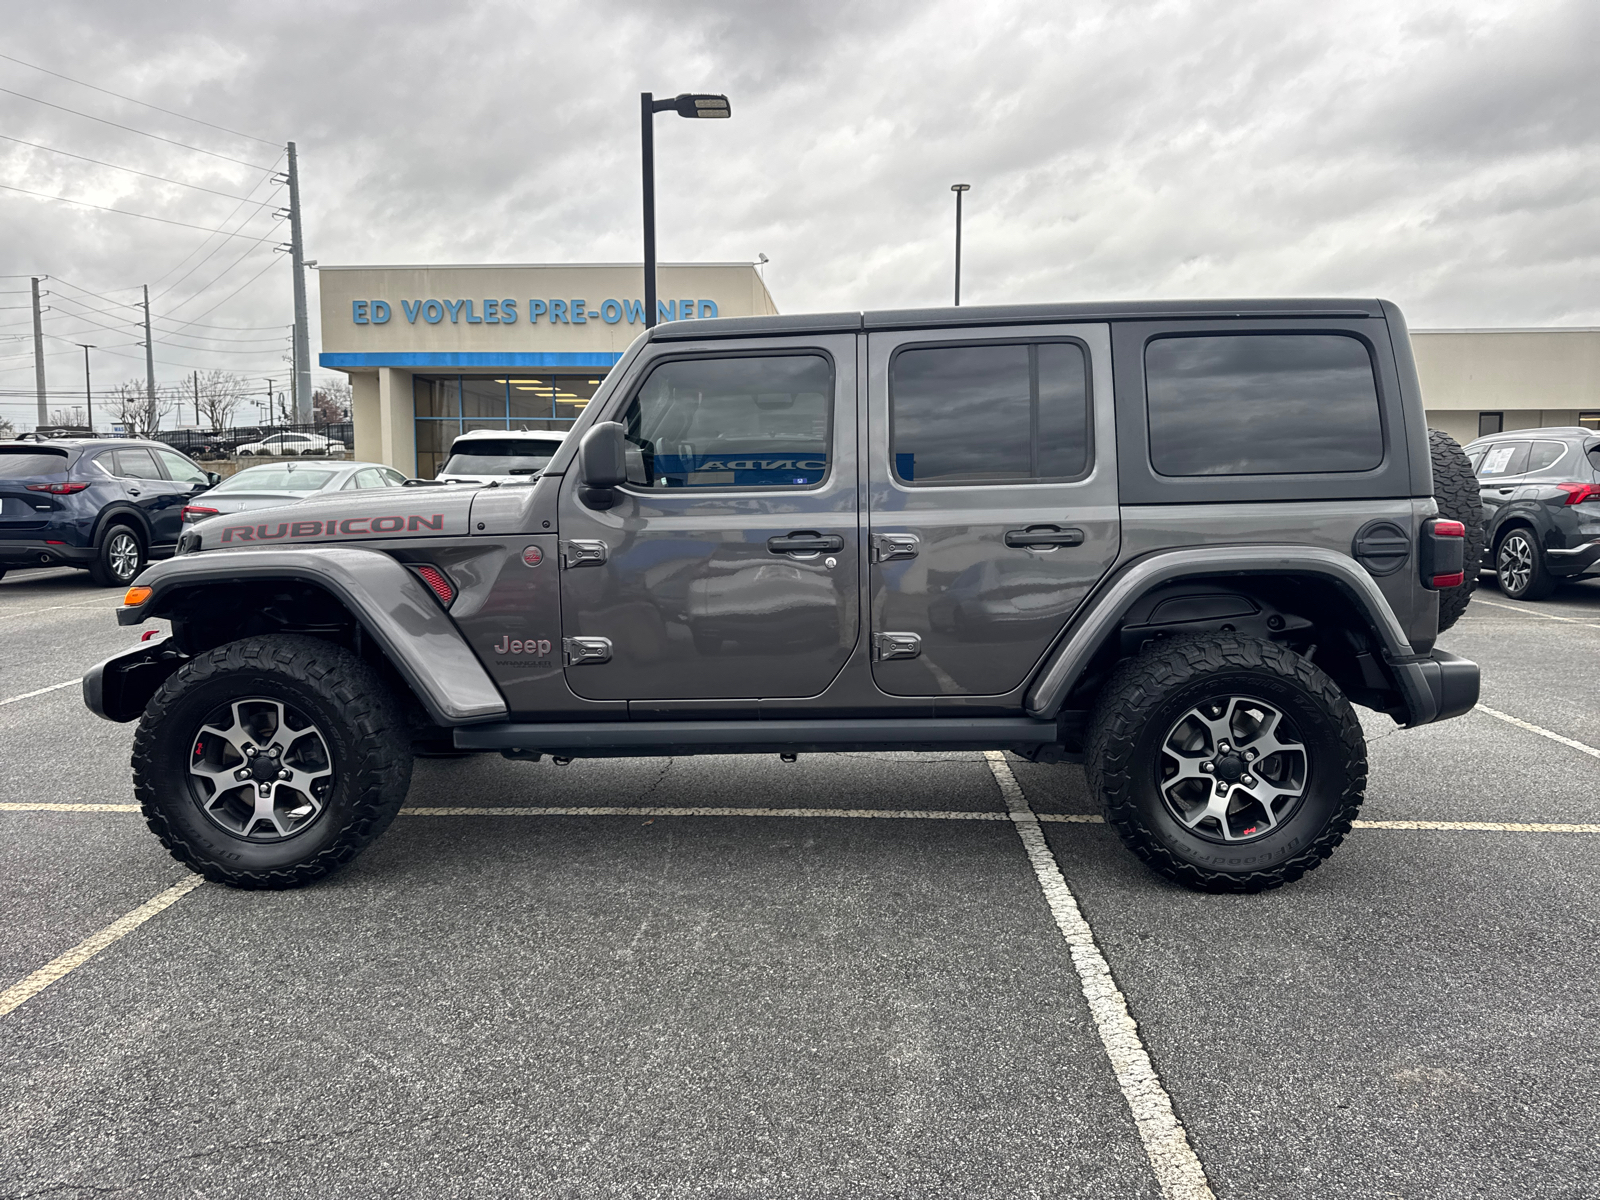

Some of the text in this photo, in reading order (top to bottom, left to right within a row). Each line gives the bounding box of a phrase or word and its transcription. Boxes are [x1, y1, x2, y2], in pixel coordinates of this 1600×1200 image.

[352, 298, 719, 325] ED VOYLES PRE-OWNED
[220, 514, 445, 544] RUBICON
[494, 635, 552, 658] Jeep
